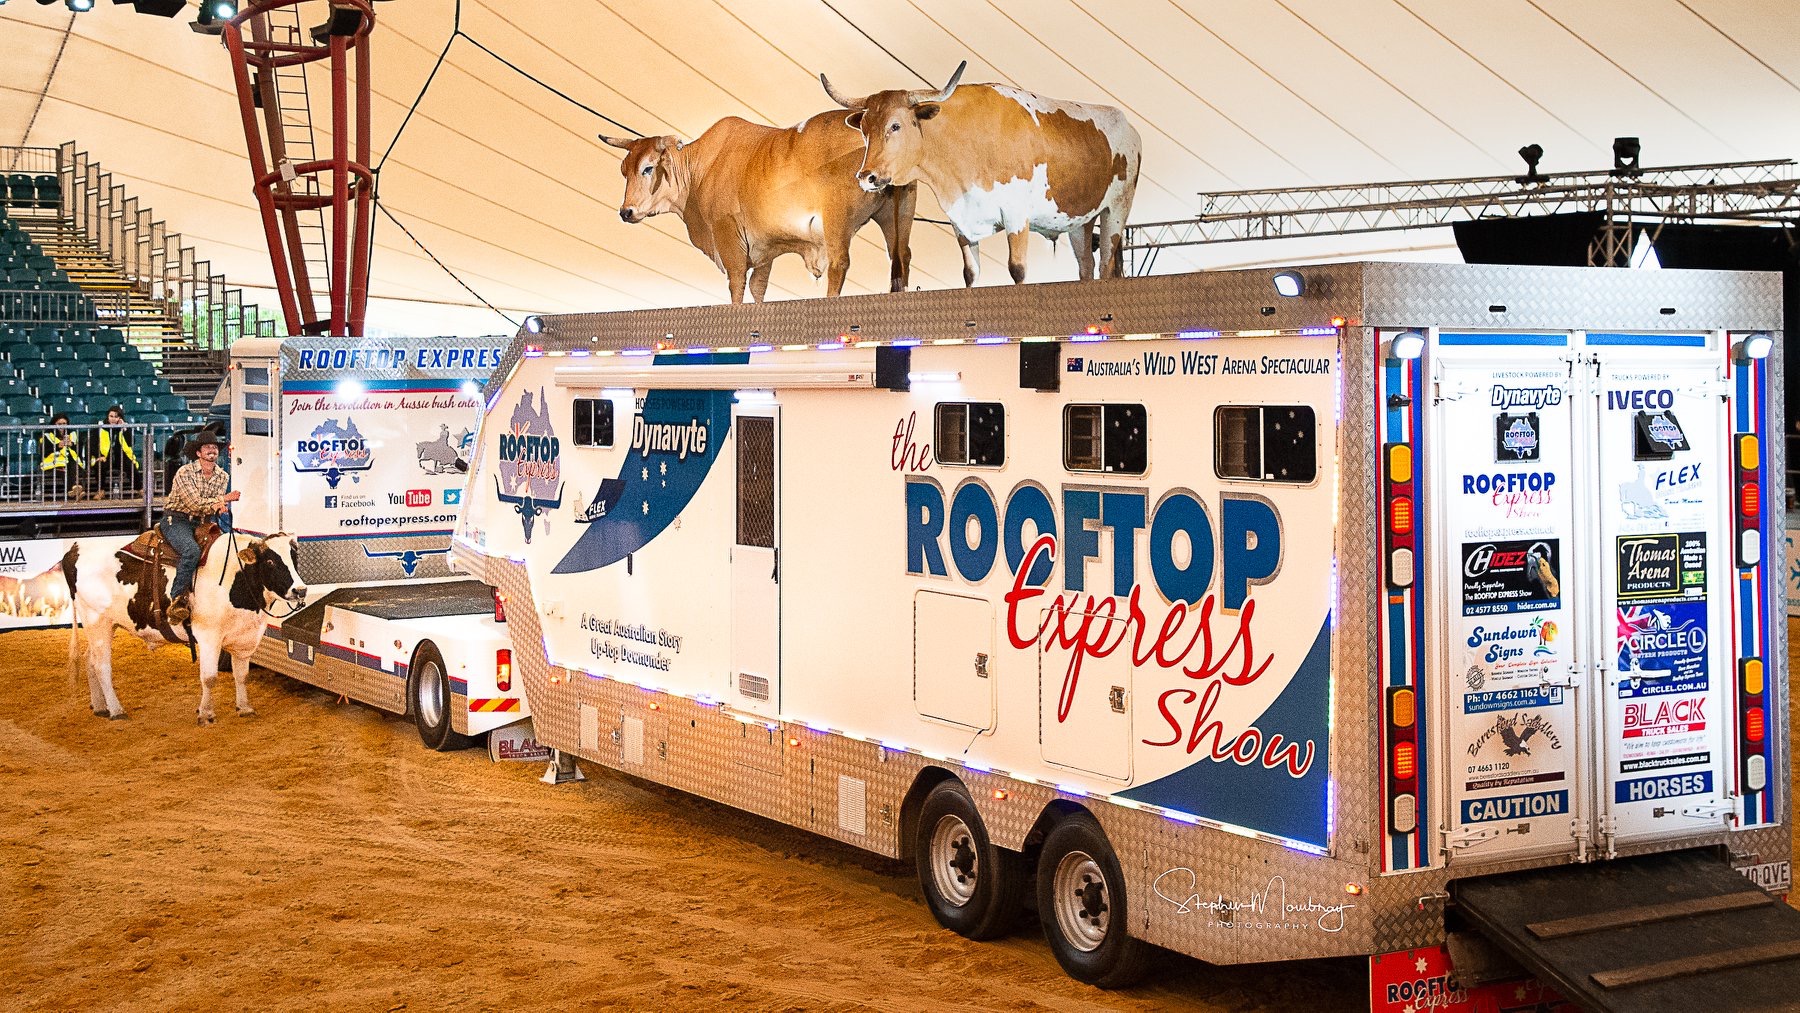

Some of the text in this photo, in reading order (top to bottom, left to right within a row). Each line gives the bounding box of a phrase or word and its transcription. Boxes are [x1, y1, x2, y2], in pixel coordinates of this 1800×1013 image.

[299, 349, 406, 370] ROOFTOP
[1086, 350, 1330, 376] AUSTRALIA'S WILD WEST ARENA SPECTACULAR
[1492, 371, 1524, 379] LIVESTOCK
[1525, 371, 1554, 379] POWERED
[289, 398, 313, 415] Join
[314, 397, 331, 411] the
[332, 397, 381, 411] revolution
[384, 399, 395, 409] in
[395, 397, 430, 410] Aussie
[431, 395, 456, 410] bush
[1491, 385, 1562, 410] Dynavyte
[1607, 389, 1674, 410] IVECO
[632, 415, 707, 460] Dynavyte
[890, 410, 934, 473] the
[1505, 431, 1535, 439] ROOFTOP
[499, 433, 560, 465] ROOFTOP
[516, 448, 559, 493] Express
[1655, 463, 1702, 490] FLEX
[1463, 472, 1556, 494] ROOFTOP
[341, 498, 376, 508] Facebook
[588, 500, 606, 516] FLEX
[1492, 482, 1553, 519] Express
[340, 514, 457, 528] rooftopexpress.com
[904, 475, 1286, 616] ROOFTOP
[1621, 539, 1676, 567] Thomas
[1473, 549, 1528, 571] HIDEZ
[1627, 560, 1671, 580] Arena
[1464, 593, 1474, 601] The
[1474, 592, 1498, 600] ROOFTOP
[1498, 590, 1519, 599] EXPRESS
[1482, 581, 1505, 591] Supporting
[1627, 581, 1671, 590] PRODUCTS
[1465, 604, 1508, 615] 02 4577 8550
[1516, 602, 1557, 610] hidez.com.au
[580, 613, 683, 654] A Great Australian Story
[1004, 536, 1275, 723] Express
[1467, 625, 1538, 648] Sundown
[1629, 631, 1702, 651] CIRCLE L
[590, 638, 672, 672] Up-Top Downunder
[1485, 644, 1524, 662] Signs
[1657, 649, 1688, 658] PRODUCTS
[1467, 689, 1538, 704] Ph: 07 4662 1162
[1642, 682, 1707, 695] CIRCLEL.COM.AU
[1468, 698, 1537, 712] sundownsigns.com.au
[1624, 697, 1706, 729] BLACK
[1142, 679, 1315, 778] Show
[1467, 712, 1562, 758] Beresford Saddlery
[1642, 724, 1689, 736] TRUCK SALES
[499, 738, 547, 753] BLAC
[1468, 762, 1510, 774] 07 4663 1120
[1623, 755, 1708, 771] www.blacktrucksales.com.au
[1472, 776, 1535, 789] Quality by Reputation
[1629, 774, 1705, 801] HORSES
[1468, 793, 1560, 821] CAUTION
